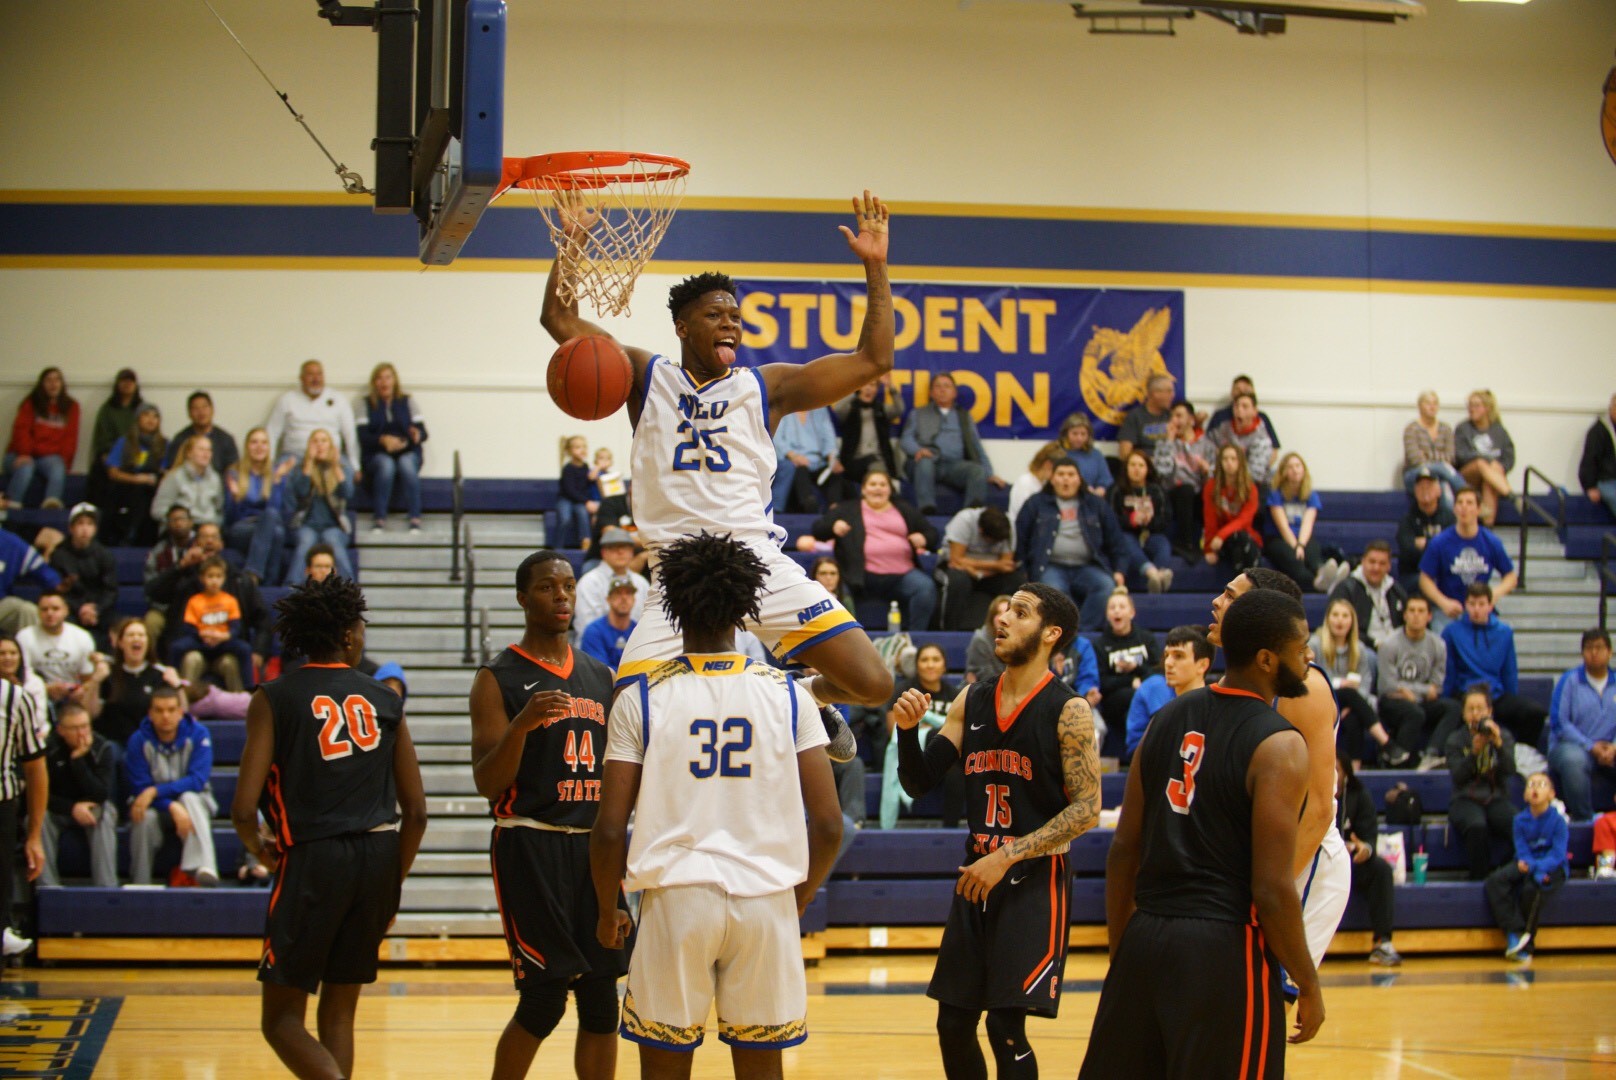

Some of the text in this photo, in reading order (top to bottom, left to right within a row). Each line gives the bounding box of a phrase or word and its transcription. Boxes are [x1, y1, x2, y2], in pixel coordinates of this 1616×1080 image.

[739, 291, 1057, 355] STUDENT
[677, 393, 729, 420] NEO
[673, 420, 732, 473] 25
[797, 598, 834, 625] NEO
[702, 660, 735, 673] NEO
[311, 694, 382, 762] 20
[563, 729, 596, 773] 44
[688, 716, 754, 780] 32
[557, 779, 602, 802] STATE
[1165, 730, 1206, 816] 3
[985, 783, 1013, 829] 15
